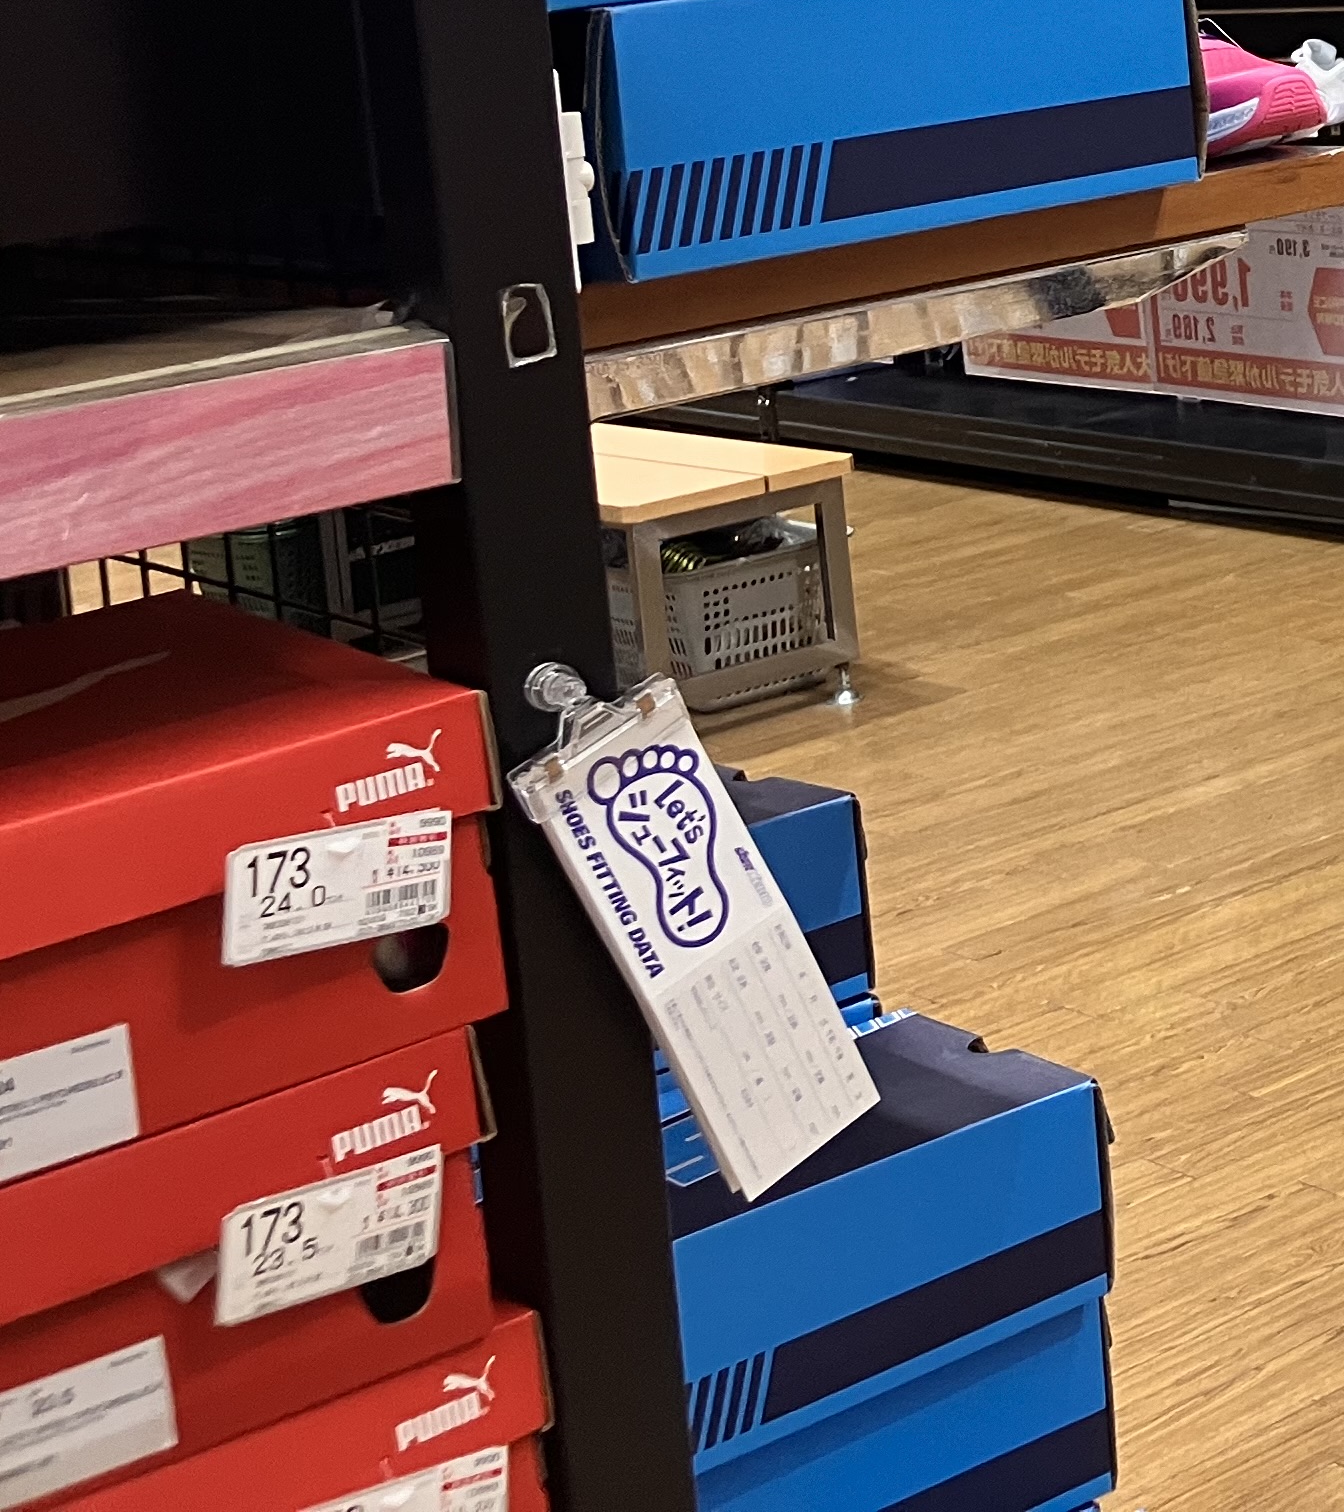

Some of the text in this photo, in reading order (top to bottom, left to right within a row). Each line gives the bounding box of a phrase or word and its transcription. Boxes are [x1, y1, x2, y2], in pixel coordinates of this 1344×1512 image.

[336, 761, 428, 813] PUMA
[653, 778, 707, 844] Let's
[247, 846, 311, 898] 173
[555, 788, 665, 979] SHOES FITTING DATA
[617, 789, 714, 933] シューフィット!
[259, 885, 327, 918] 24.0
[332, 1105, 424, 1162] PUMA
[240, 1200, 304, 1258] 173
[252, 1236, 319, 1277] 23.5
